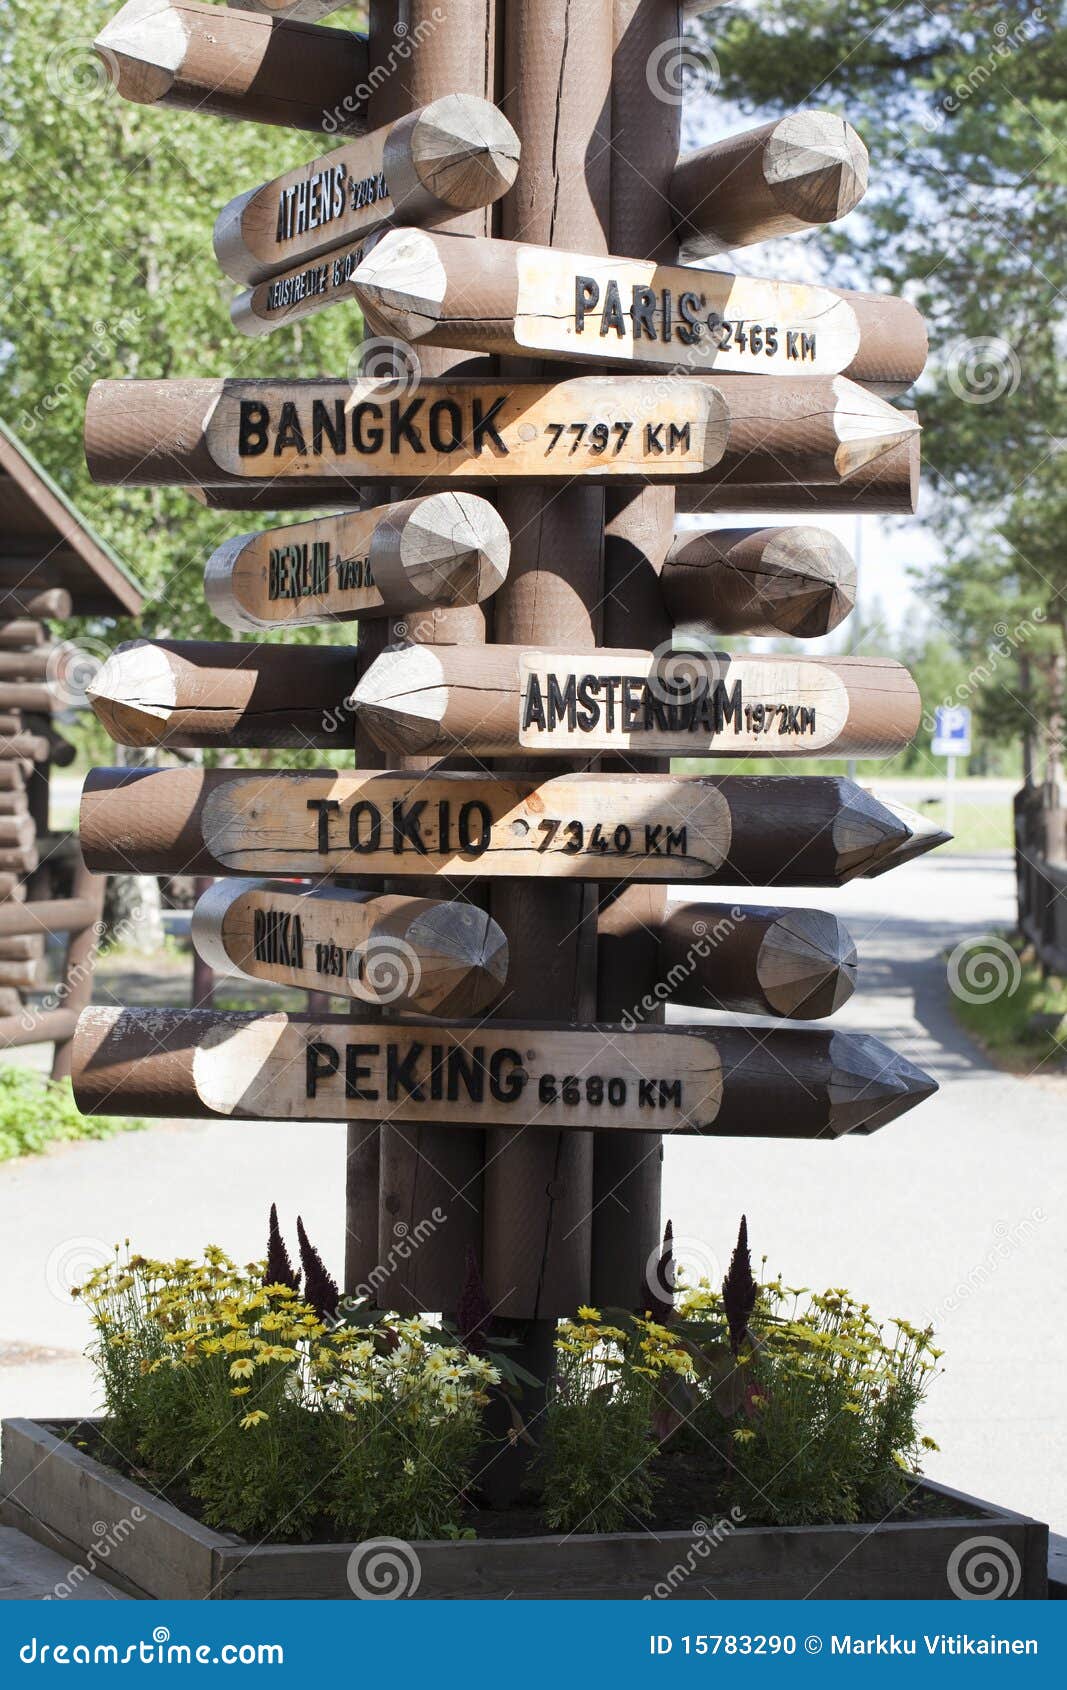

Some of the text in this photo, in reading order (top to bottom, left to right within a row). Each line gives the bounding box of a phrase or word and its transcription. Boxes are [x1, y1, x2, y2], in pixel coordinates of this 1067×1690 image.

[276, 163, 346, 242] ATHENS
[575, 276, 816, 361] PARIS 2465 KM
[238, 397, 691, 458] BANGKOK 7797 KM
[268, 541, 330, 600] BERLIN
[522, 672, 743, 734] AMSTERDAM
[306, 799, 689, 857] TOKIO 7340 KM
[306, 1041, 683, 1109] PEKING 6680 KM
